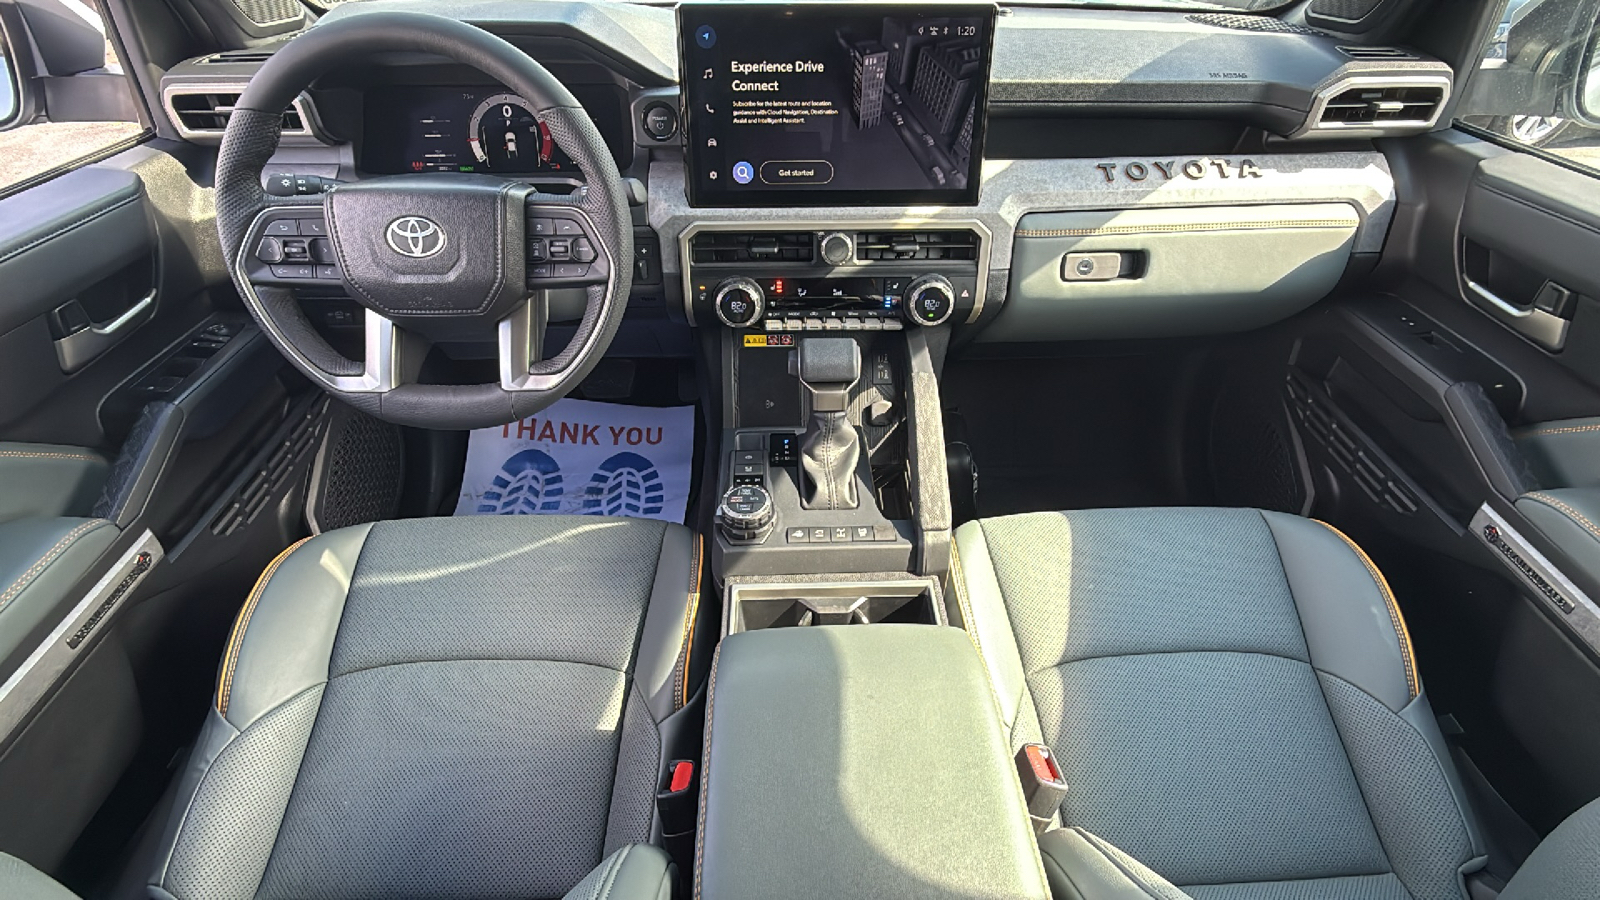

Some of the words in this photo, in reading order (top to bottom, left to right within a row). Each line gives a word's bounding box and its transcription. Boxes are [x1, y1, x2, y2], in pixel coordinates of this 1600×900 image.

[957, 26, 976, 36] 1:20
[731, 60, 793, 75] Experience
[795, 60, 824, 73] Drive
[731, 80, 780, 92] Connect
[502, 104, 512, 118] 0
[1097, 158, 1263, 183] TOYOTA
[608, 426, 663, 446] YOU
